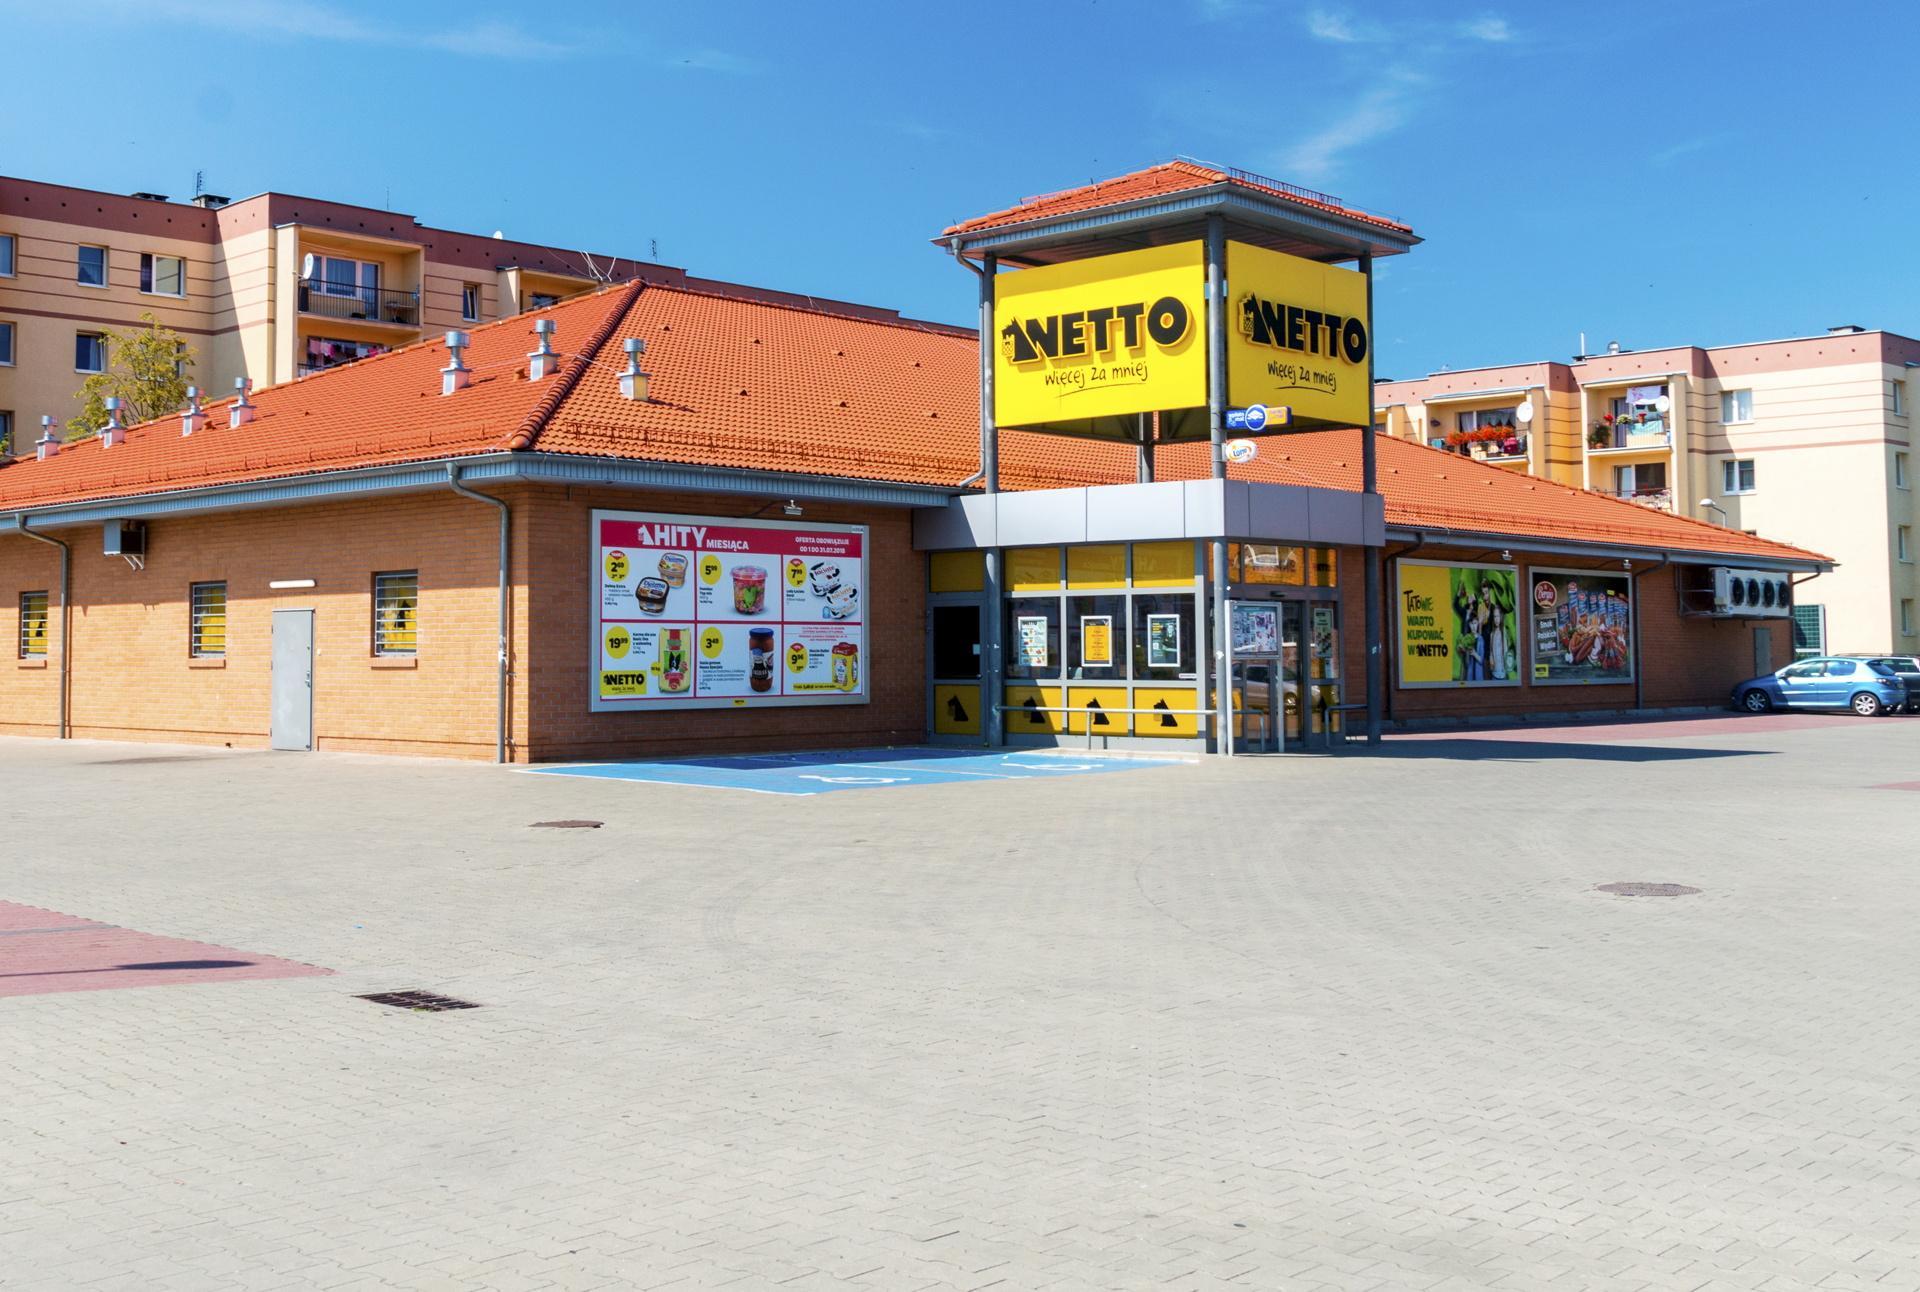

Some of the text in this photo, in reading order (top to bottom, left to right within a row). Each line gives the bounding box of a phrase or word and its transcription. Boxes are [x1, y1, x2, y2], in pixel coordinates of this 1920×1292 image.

[1025, 296, 1188, 359] NETTO
[1261, 300, 1367, 364] NETTO
[1112, 361, 1148, 381] mniej
[1313, 370, 1337, 392] mniej
[654, 524, 750, 552] HITY MIESIĄCA
[1407, 616, 1434, 626] WARTO
[1407, 627, 1444, 640] KUPOWAĆ
[1419, 644, 1448, 657] NETTO
[609, 674, 645, 685] NETTO
